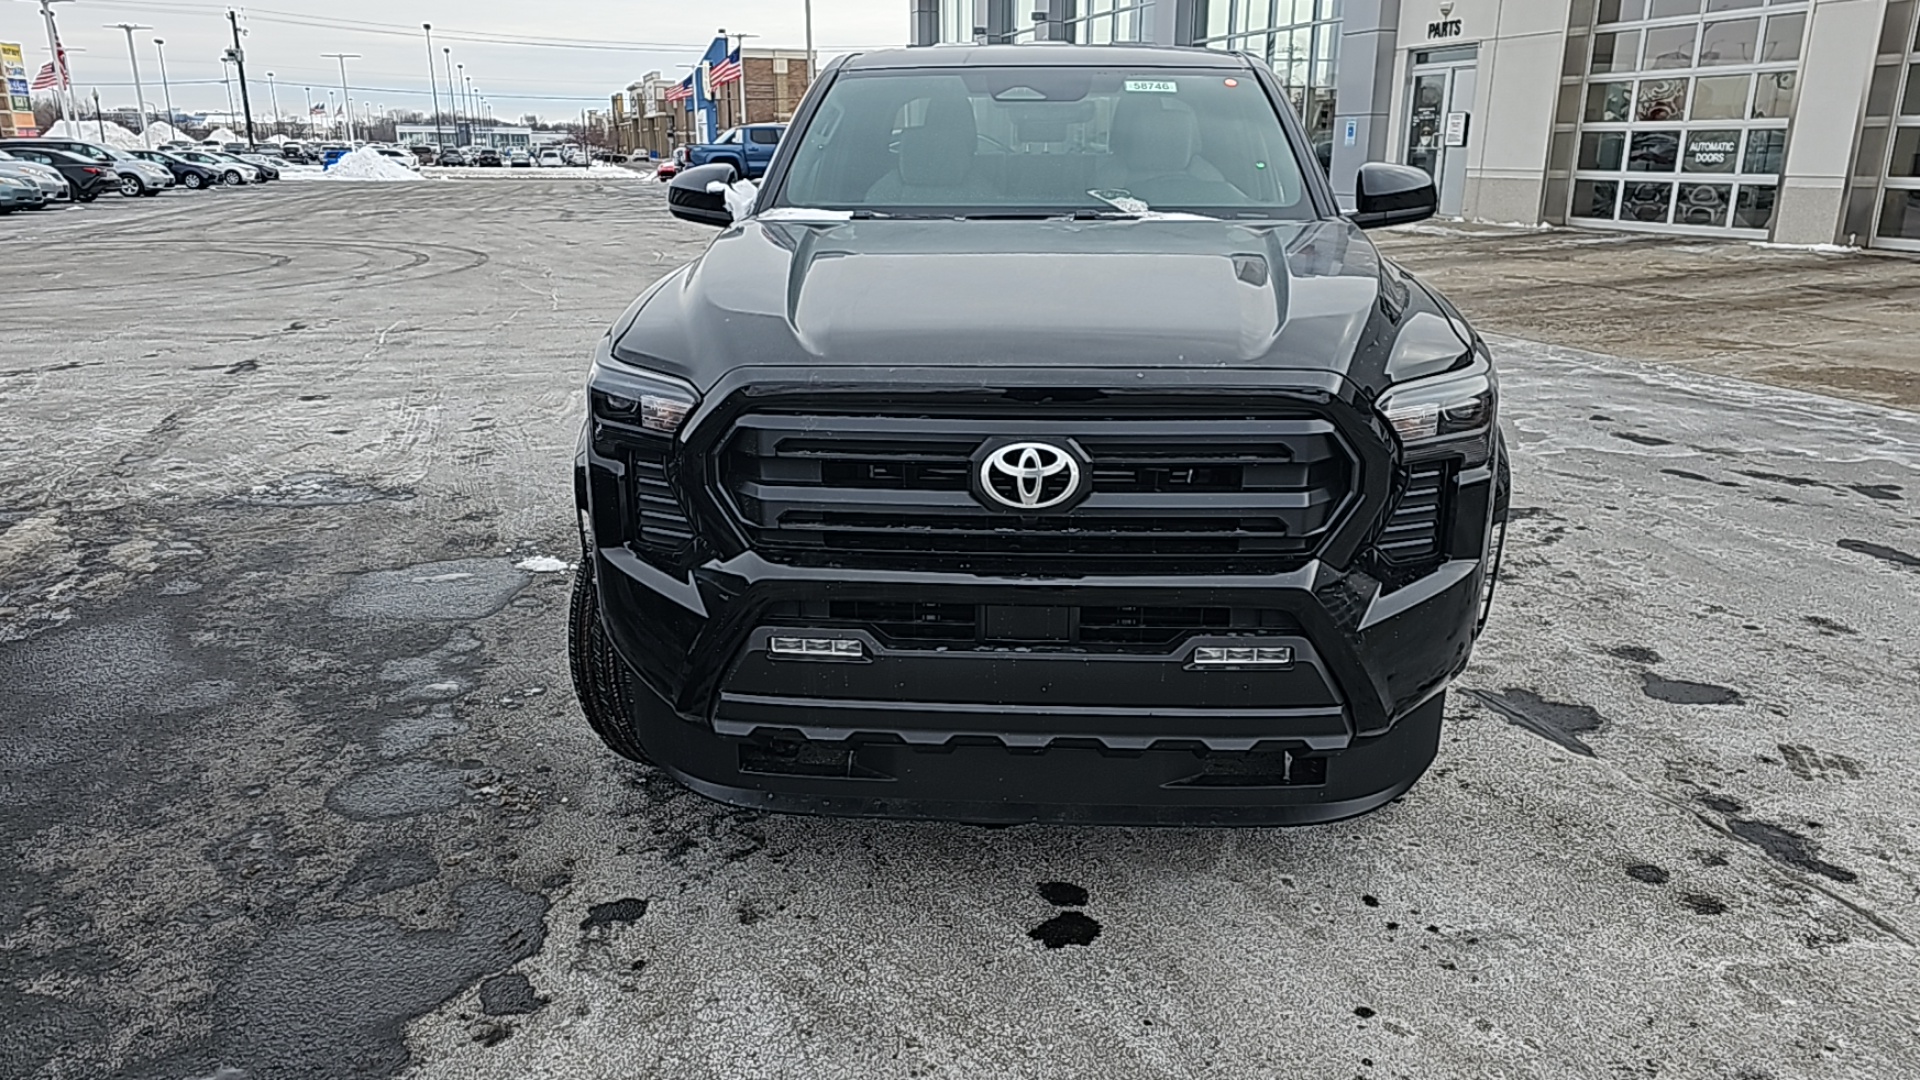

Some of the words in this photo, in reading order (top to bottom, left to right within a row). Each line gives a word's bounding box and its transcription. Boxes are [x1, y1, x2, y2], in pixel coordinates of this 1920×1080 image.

[1427, 19, 1462, 39] PARTS
[1133, 82, 1170, 90] 58746
[1689, 141, 1735, 152] AUTOMATIC
[1695, 153, 1725, 163] DOORS
